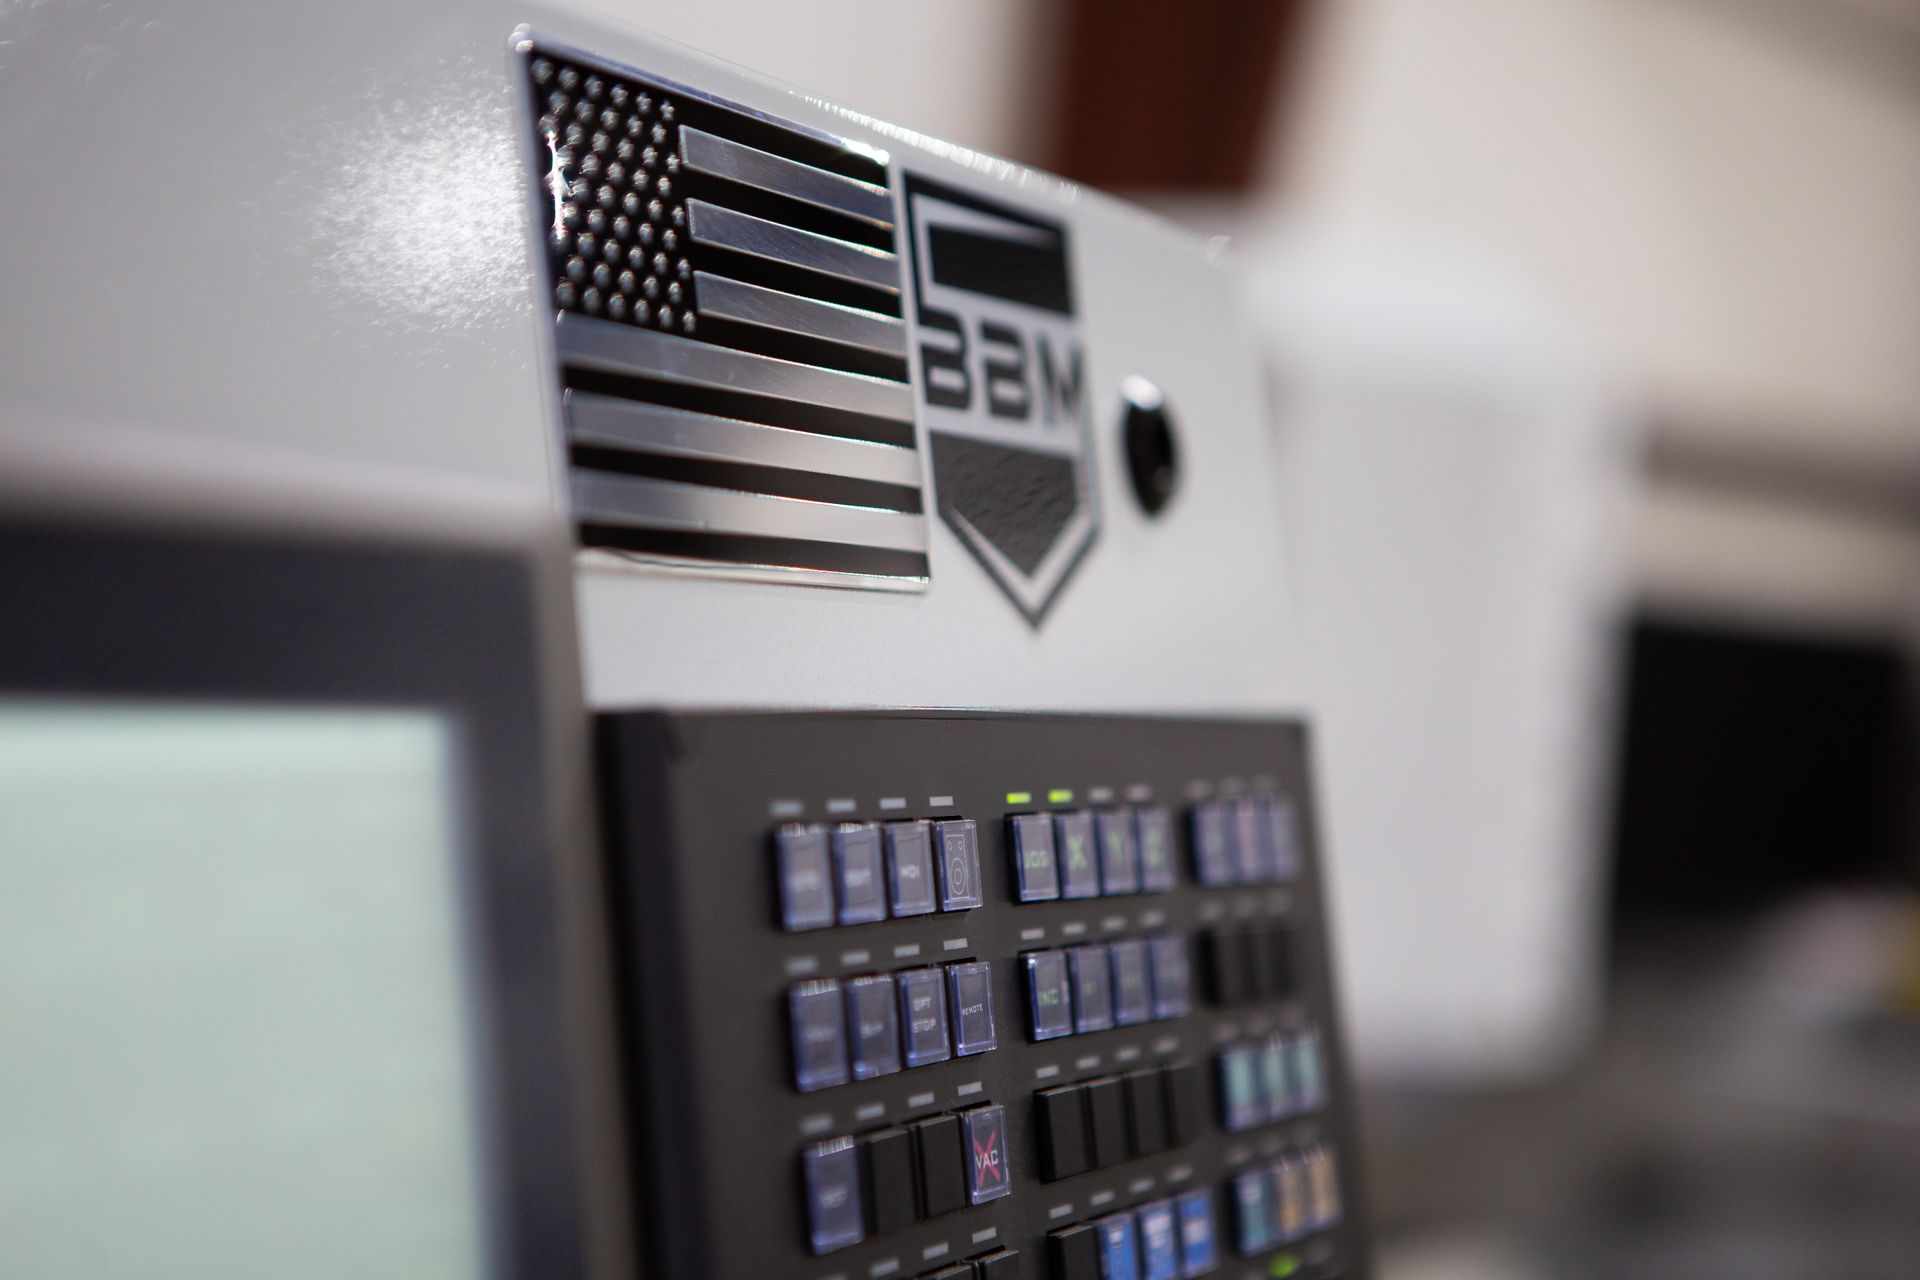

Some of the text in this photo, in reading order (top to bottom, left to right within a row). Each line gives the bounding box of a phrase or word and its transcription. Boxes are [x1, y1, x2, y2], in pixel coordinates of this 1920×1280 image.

[919, 307, 1086, 429] BBM
[914, 997, 932, 1011] OPT
[961, 1003, 983, 1015] REMOTE
[913, 1019, 936, 1033] STOP
[975, 1149, 999, 1169] VAC
